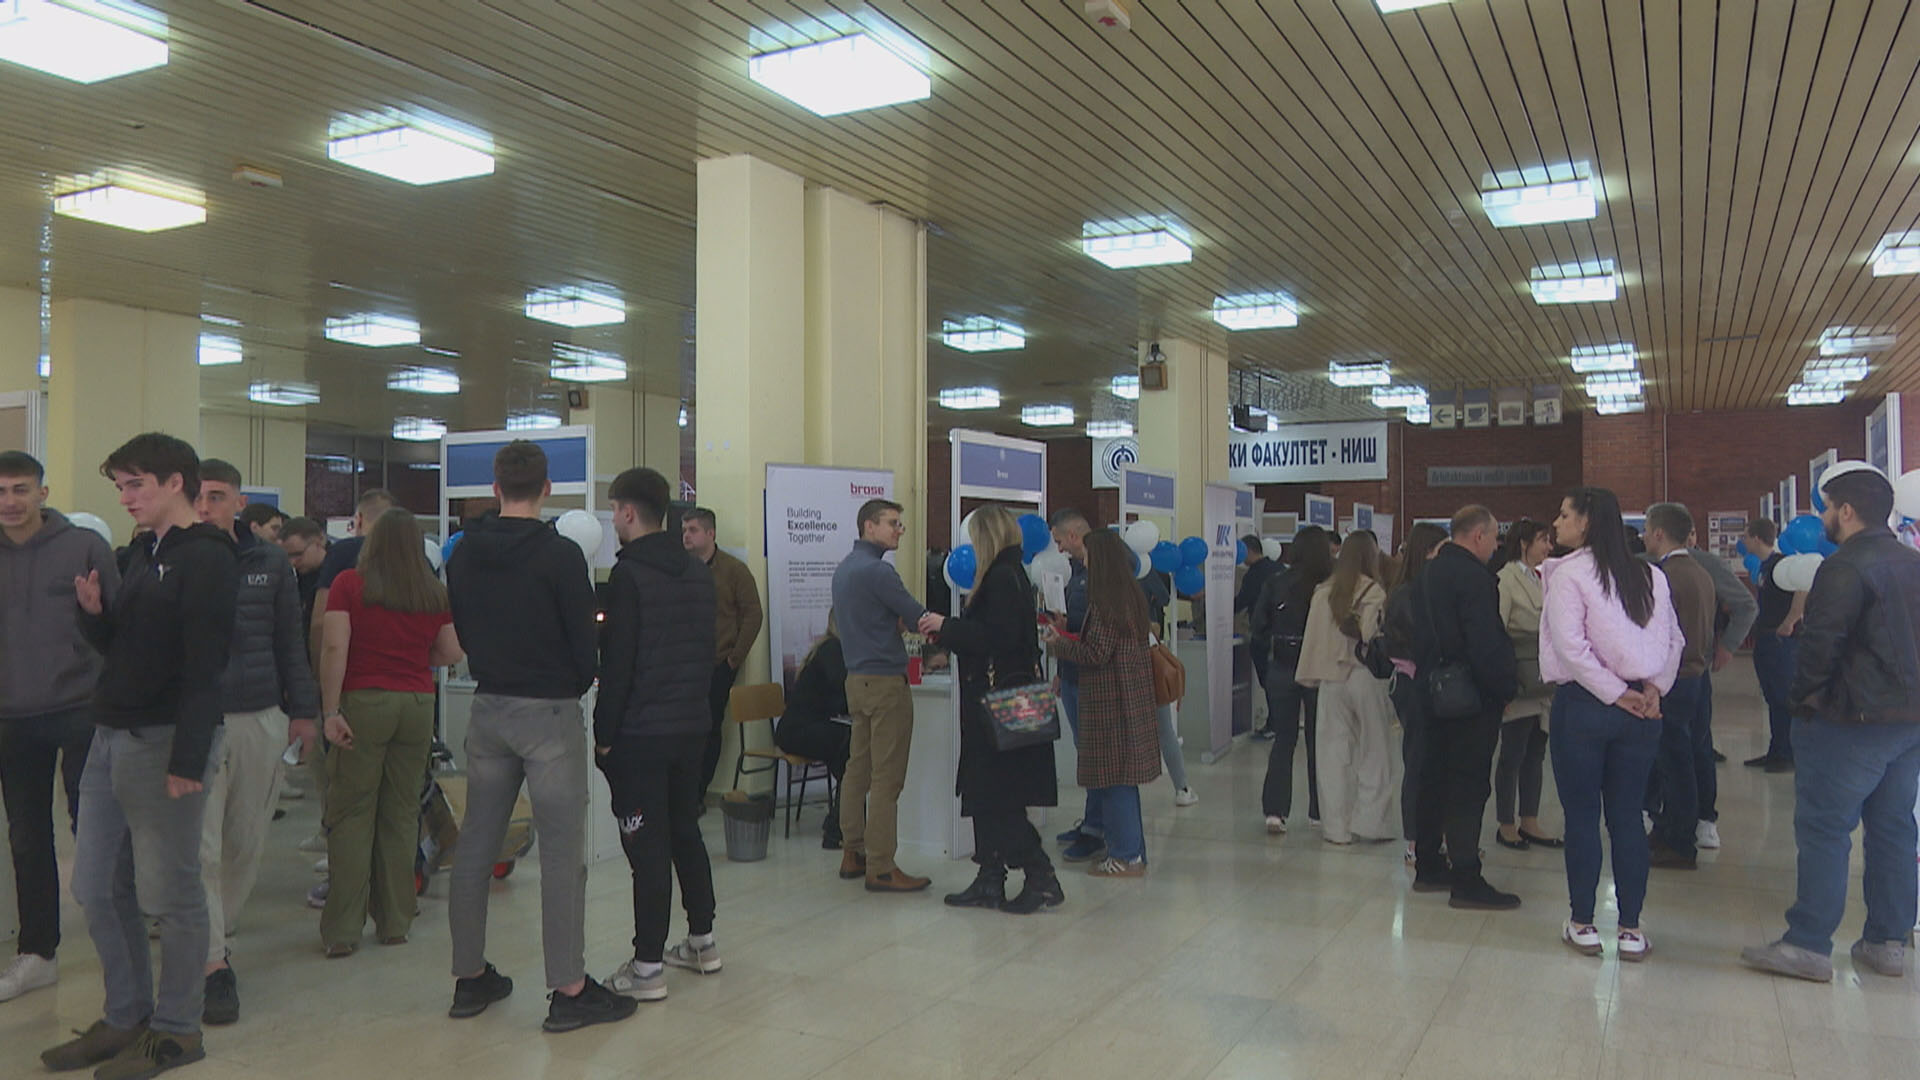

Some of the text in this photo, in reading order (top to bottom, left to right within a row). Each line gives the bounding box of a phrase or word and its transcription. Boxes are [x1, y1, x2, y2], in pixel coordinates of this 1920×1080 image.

[1251, 439, 1328, 467] ФАКУЛТЕТ
[1341, 437, 1377, 464] НИШ
[786, 507, 822, 519] Building
[787, 520, 838, 531] Excellence
[788, 533, 825, 544] Together
